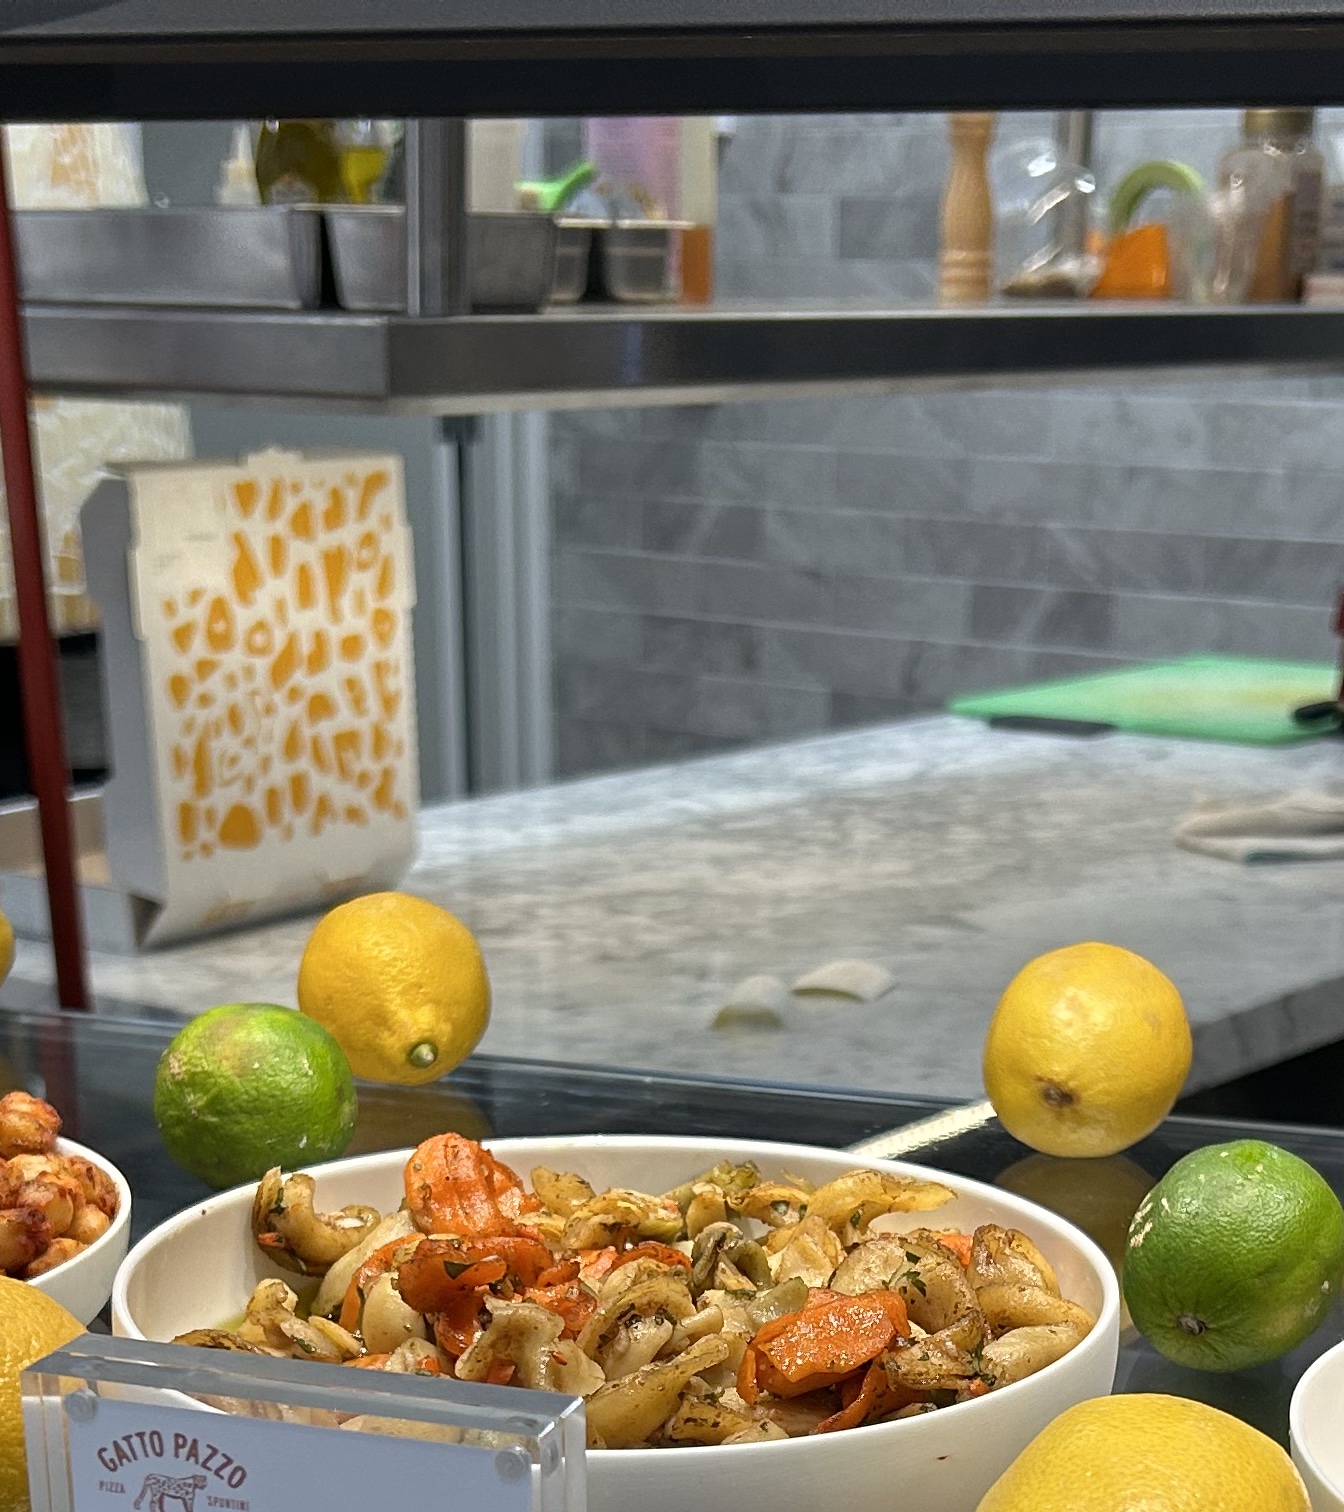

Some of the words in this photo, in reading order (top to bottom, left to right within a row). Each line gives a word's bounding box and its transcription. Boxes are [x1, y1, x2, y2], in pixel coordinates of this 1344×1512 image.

[97, 1430, 164, 1473] GATTO
[173, 1432, 247, 1489] PAZZO
[99, 1480, 126, 1493] PIZZA
